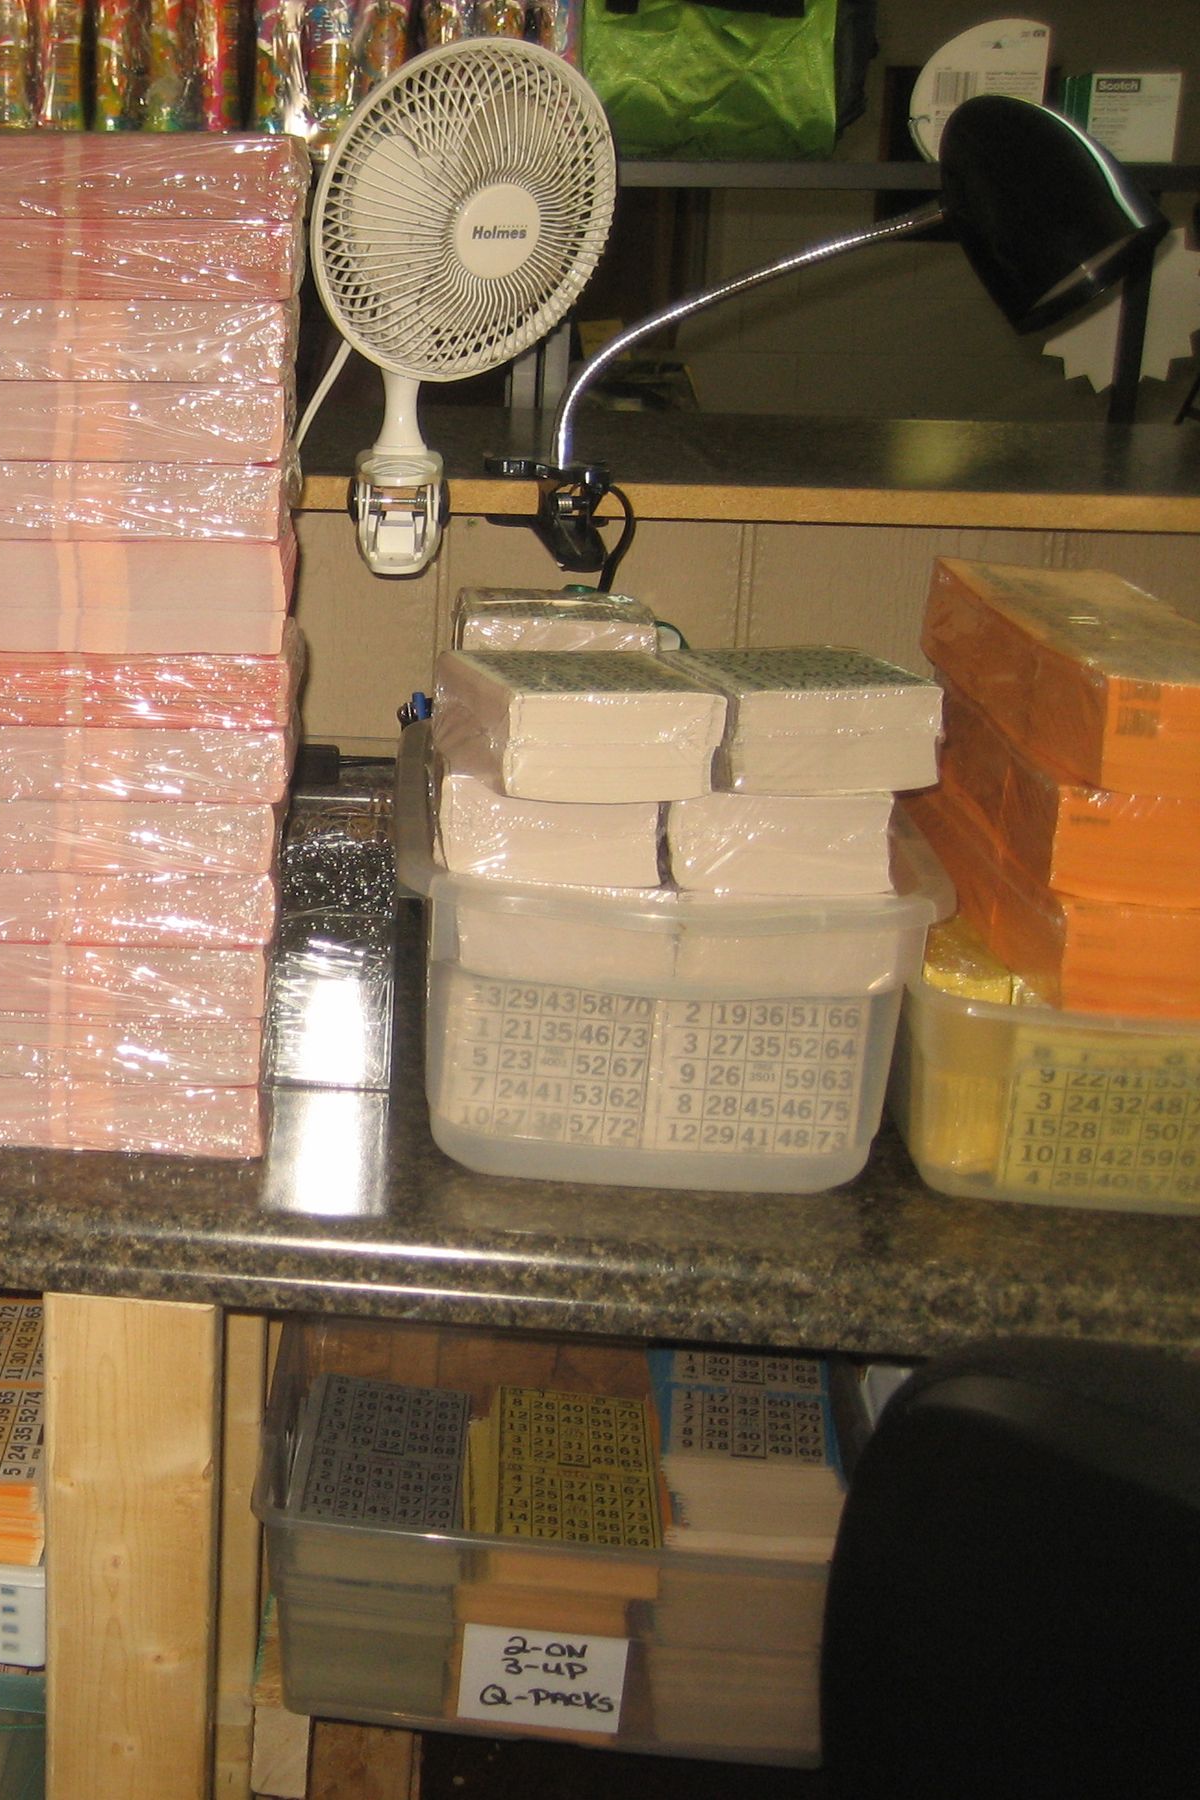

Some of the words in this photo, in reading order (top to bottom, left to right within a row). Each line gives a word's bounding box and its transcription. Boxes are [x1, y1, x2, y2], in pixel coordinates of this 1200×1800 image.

[1097, 80, 1140, 91] Scotch
[472, 225, 527, 239] Holmes
[508, 988, 539, 1009] 29
[545, 991, 576, 1013] 43
[582, 994, 613, 1014] 58
[622, 997, 651, 1017] 70
[686, 1002, 701, 1024] 2
[717, 1004, 747, 1025] 19
[754, 1005, 784, 1026] 36
[791, 1007, 820, 1027] 51
[828, 1008, 860, 1029] 66
[476, 1018, 489, 1037] 1
[504, 1018, 534, 1040] 21
[542, 1022, 573, 1043] 35
[580, 1024, 610, 1046] 46
[618, 1027, 647, 1048] 73
[684, 1033, 698, 1054] 3
[712, 1035, 744, 1056] 27
[751, 1036, 781, 1057] 35
[789, 1038, 819, 1059] 52
[825, 1039, 856, 1060] 64
[472, 1047, 488, 1067] 5
[502, 1049, 533, 1070] 23
[575, 1055, 607, 1076] 52
[612, 1057, 643, 1078] 67
[680, 1063, 695, 1084] 9
[709, 1065, 741, 1086] 26
[785, 1068, 816, 1089] 59
[822, 1070, 853, 1090] 63
[471, 1077, 485, 1097] 7
[498, 1079, 529, 1099] 24
[535, 1082, 563, 1102] 41
[573, 1085, 603, 1105] 53
[609, 1088, 641, 1109] 62
[1036, 1092, 1052, 1111] 3
[1068, 1095, 1100, 1113] 24
[1110, 1097, 1142, 1115] 32
[1150, 1098, 1182, 1115] 48
[677, 1093, 692, 1114] 8
[706, 1095, 737, 1116] 28
[744, 1098, 774, 1118] 45
[782, 1099, 812, 1119] 46
[819, 1101, 849, 1121] 75
[459, 1105, 489, 1125] 10
[569, 1115, 600, 1134] 57
[606, 1117, 637, 1137] 72
[1025, 1118, 1056, 1136] 15
[1064, 1121, 1097, 1139] 28
[1145, 1123, 1178, 1141] 50
[669, 1124, 698, 1142] 12
[704, 1125, 735, 1144] 29
[741, 1127, 769, 1146] 41
[778, 1129, 809, 1148] 48
[816, 1131, 846, 1150] 73
[1022, 1145, 1053, 1163] 10
[1061, 1147, 1092, 1165] 18
[1100, 1148, 1132, 1166] 42
[509, 1411, 528, 1419] 12
[534, 1413, 555, 1422] 29
[562, 1416, 584, 1424] 43
[534, 1402, 555, 1410] 26
[562, 1404, 584, 1412] 40
[591, 1406, 610, 1415] 54
[619, 1410, 639, 1419] 70
[504, 1636, 587, 1658] 2-ON
[502, 1658, 588, 1679] 3-UP
[480, 1684, 614, 1712] Q-PACKS
